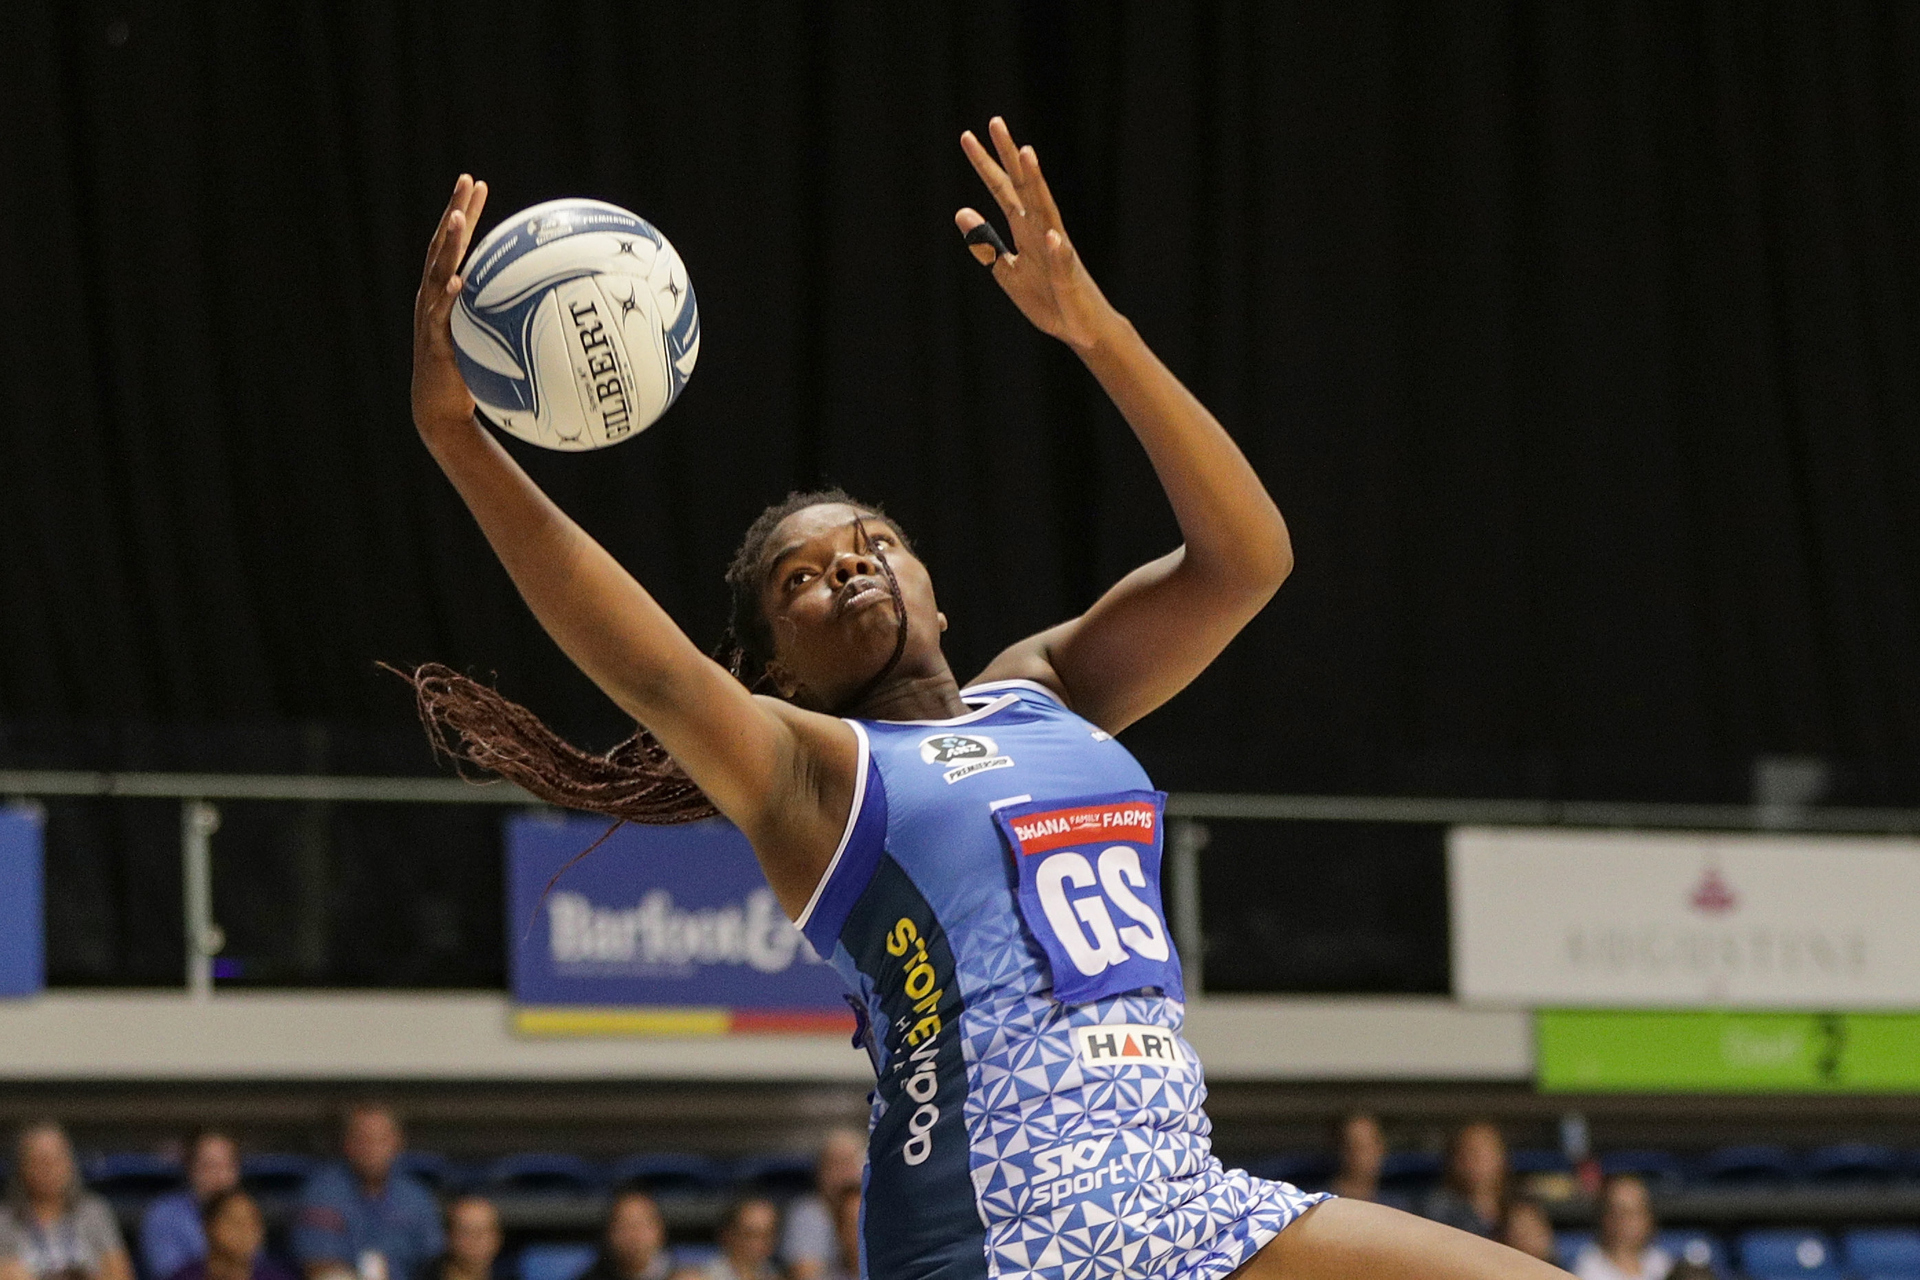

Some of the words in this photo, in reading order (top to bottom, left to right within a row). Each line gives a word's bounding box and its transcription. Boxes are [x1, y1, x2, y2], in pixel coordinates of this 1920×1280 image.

[476, 235, 519, 286] PREMIERSHIP
[569, 301, 631, 439] GILBERT
[1014, 817, 1071, 842] BHANA
[1069, 813, 1100, 825] FAMILY
[1103, 809, 1153, 829] FARMS
[1036, 845, 1170, 977] GS
[1029, 1158, 1127, 1209] sport
